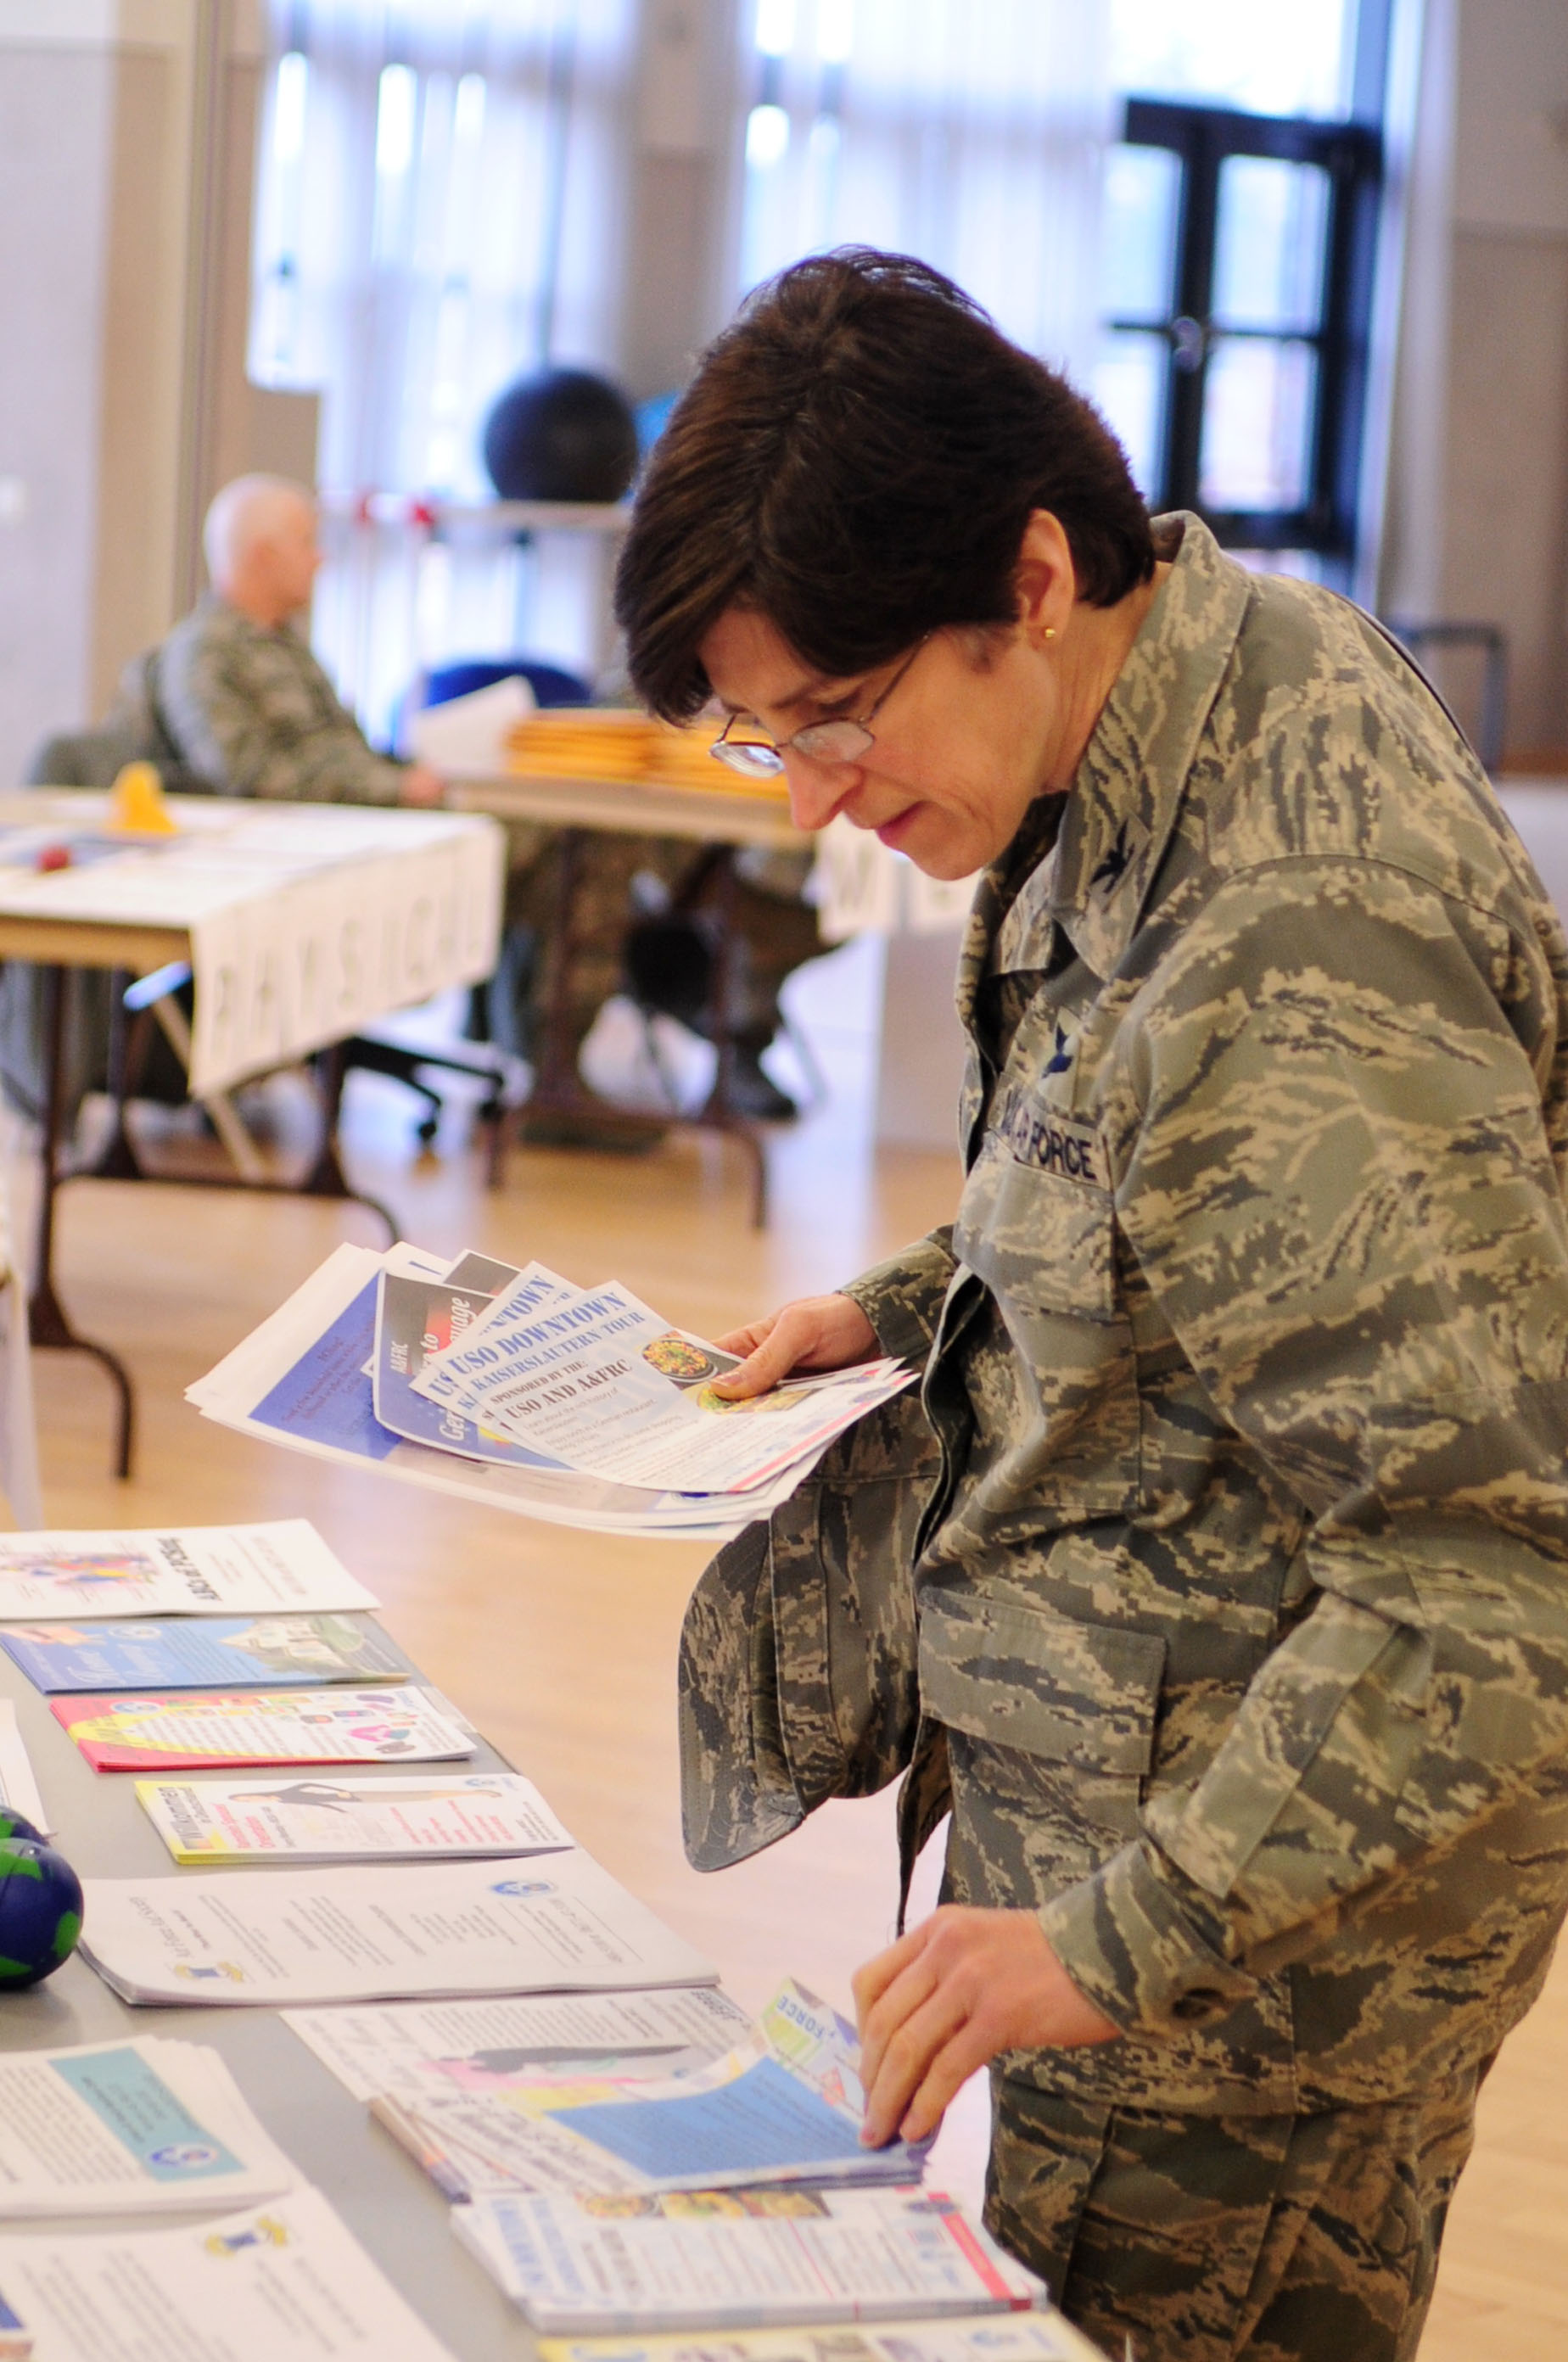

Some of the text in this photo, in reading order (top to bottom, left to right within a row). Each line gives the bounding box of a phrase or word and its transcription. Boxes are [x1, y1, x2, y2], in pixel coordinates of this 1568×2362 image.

[1030, 1120, 1097, 1180] FORCE
[446, 1292, 626, 1374] USO DOWNTOWN
[470, 1312, 646, 1391] KAISERSLAUTERN TOUR
[490, 1377, 549, 1404] SPONSORED
[547, 1371, 564, 1381] BY
[563, 1359, 590, 1374] THE:
[505, 1399, 541, 1419] USO
[541, 1384, 577, 1406] AND
[577, 1358, 632, 1391] A&FRC
